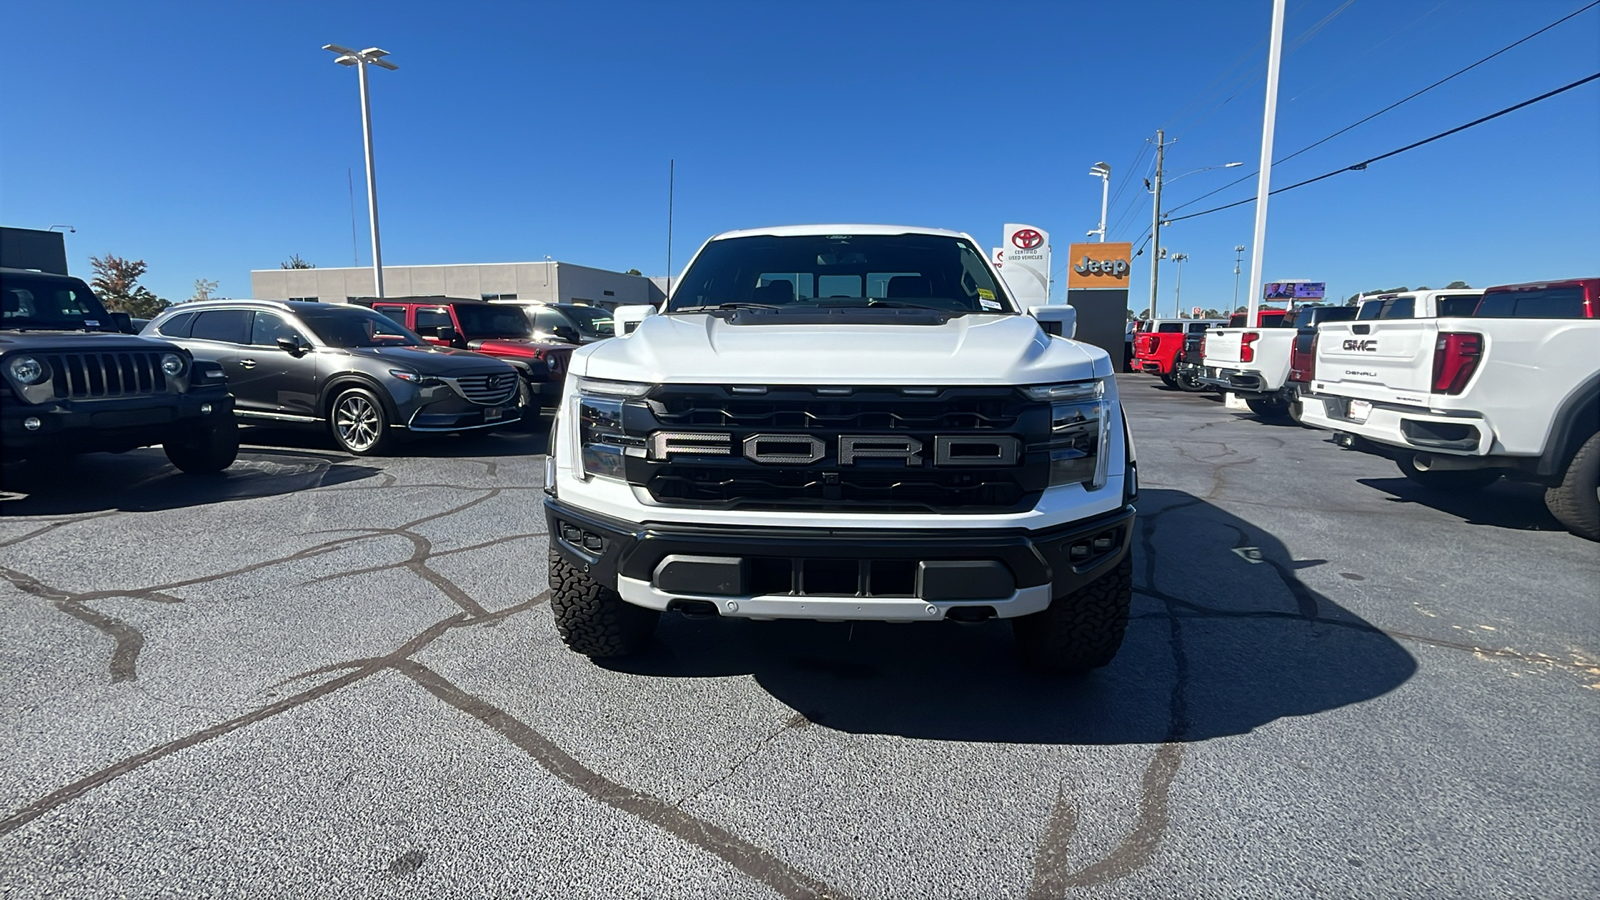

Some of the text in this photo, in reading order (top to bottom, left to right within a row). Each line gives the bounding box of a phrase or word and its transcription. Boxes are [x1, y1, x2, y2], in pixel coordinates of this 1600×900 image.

[1074, 256, 1126, 274] Jeep
[1343, 340, 1377, 351] GMC
[650, 431, 1022, 466] FORD
